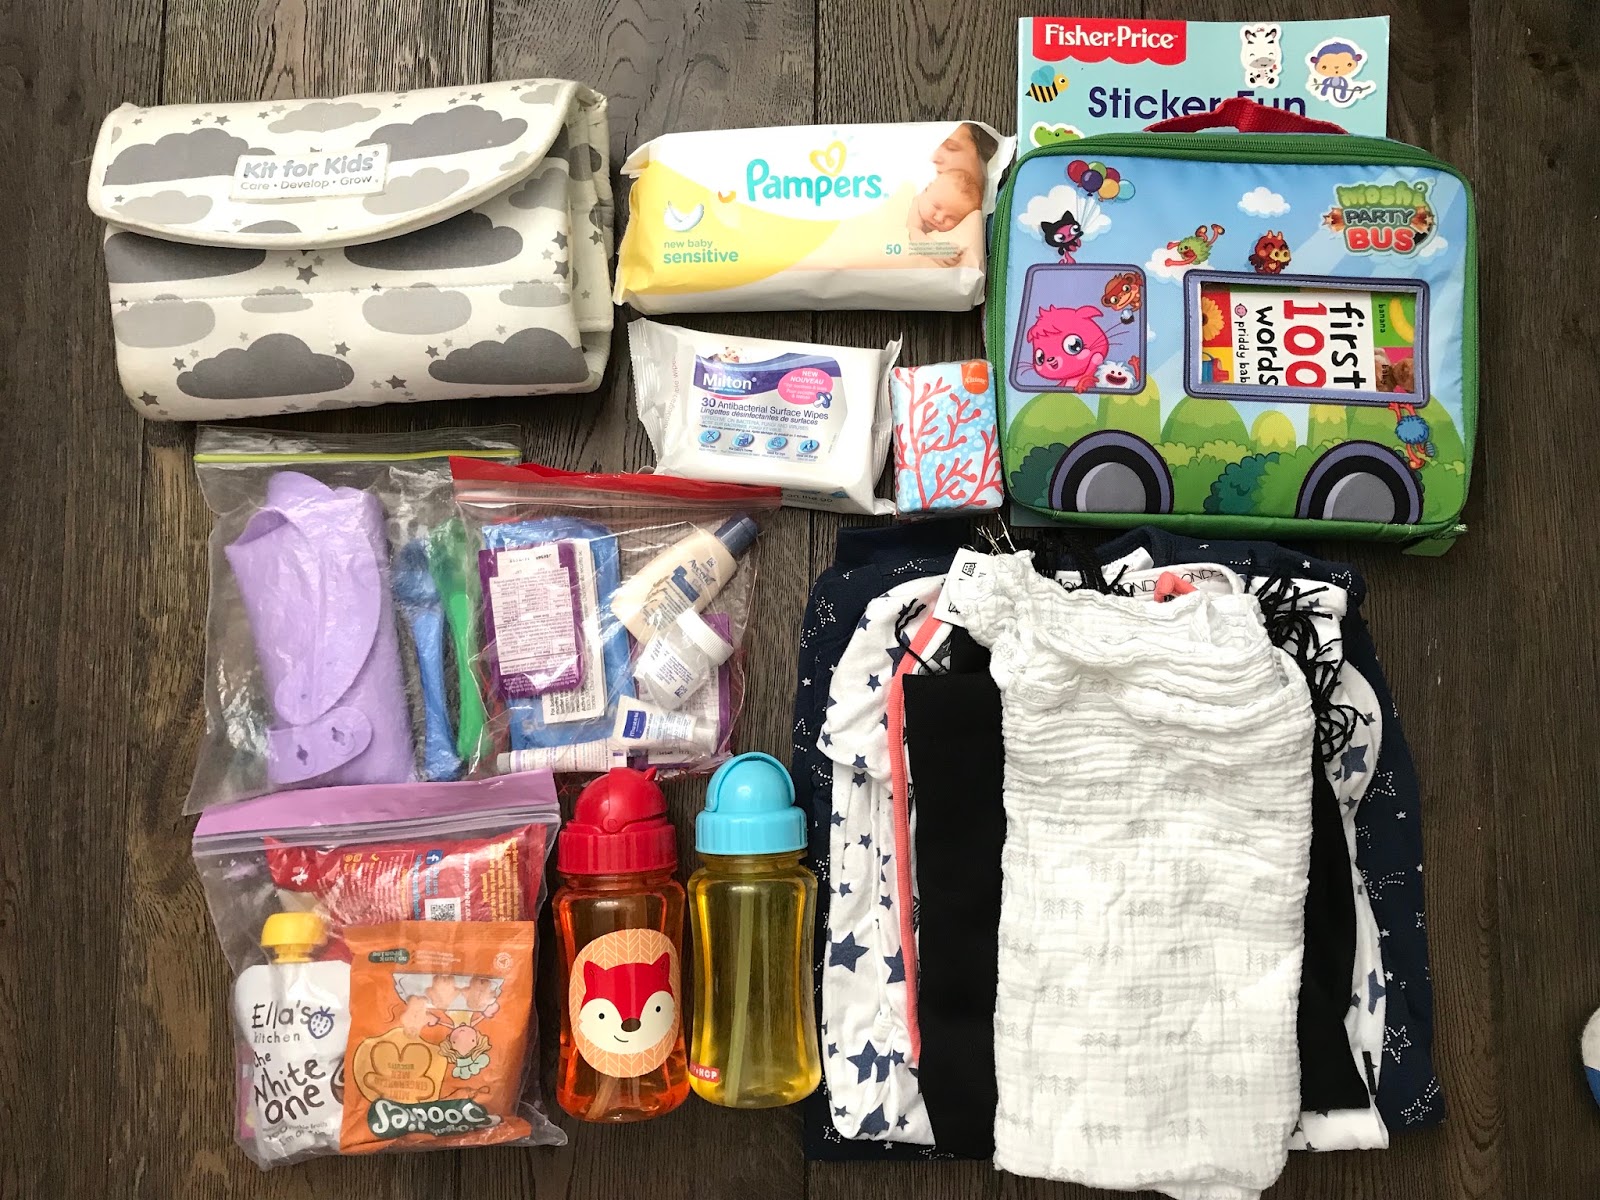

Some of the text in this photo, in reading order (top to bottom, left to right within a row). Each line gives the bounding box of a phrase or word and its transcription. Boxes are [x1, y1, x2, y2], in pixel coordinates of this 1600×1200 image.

[1045, 24, 1174, 49] Fisher-Price
[1088, 86, 1221, 120] Sticker
[244, 153, 373, 179] Kit for Kids
[240, 175, 372, 190] Care Develop Grow
[746, 158, 882, 206] Pampers
[1345, 209, 1414, 224] PARTY
[664, 239, 713, 249] new baby
[886, 244, 902, 255] 50
[1347, 228, 1414, 252] BUS
[663, 249, 739, 264] sensitive
[1378, 303, 1386, 334] banana
[1234, 321, 1251, 384] priddy bab
[1255, 306, 1284, 386] words
[1283, 300, 1328, 388] 100
[1329, 302, 1367, 389] first
[703, 373, 752, 390] Milton
[790, 376, 824, 385] NOUVEAU
[700, 407, 730, 417] Lingettes
[731, 410, 778, 422] désinfectantes
[790, 416, 818, 425] surfaces
[701, 397, 829, 420] 30 Antibacterial Surface Wipes
[1181, 569, 1224, 583] ONDS
[463, 853, 471, 920] www.pom-bear.co.
[372, 949, 402, 957] promise
[252, 1000, 311, 1029] Ella's
[254, 1031, 300, 1044] kitchen
[254, 1051, 271, 1068] the
[254, 1059, 326, 1107] White
[265, 1084, 325, 1124] one
[371, 1099, 501, 1134] Goodies
